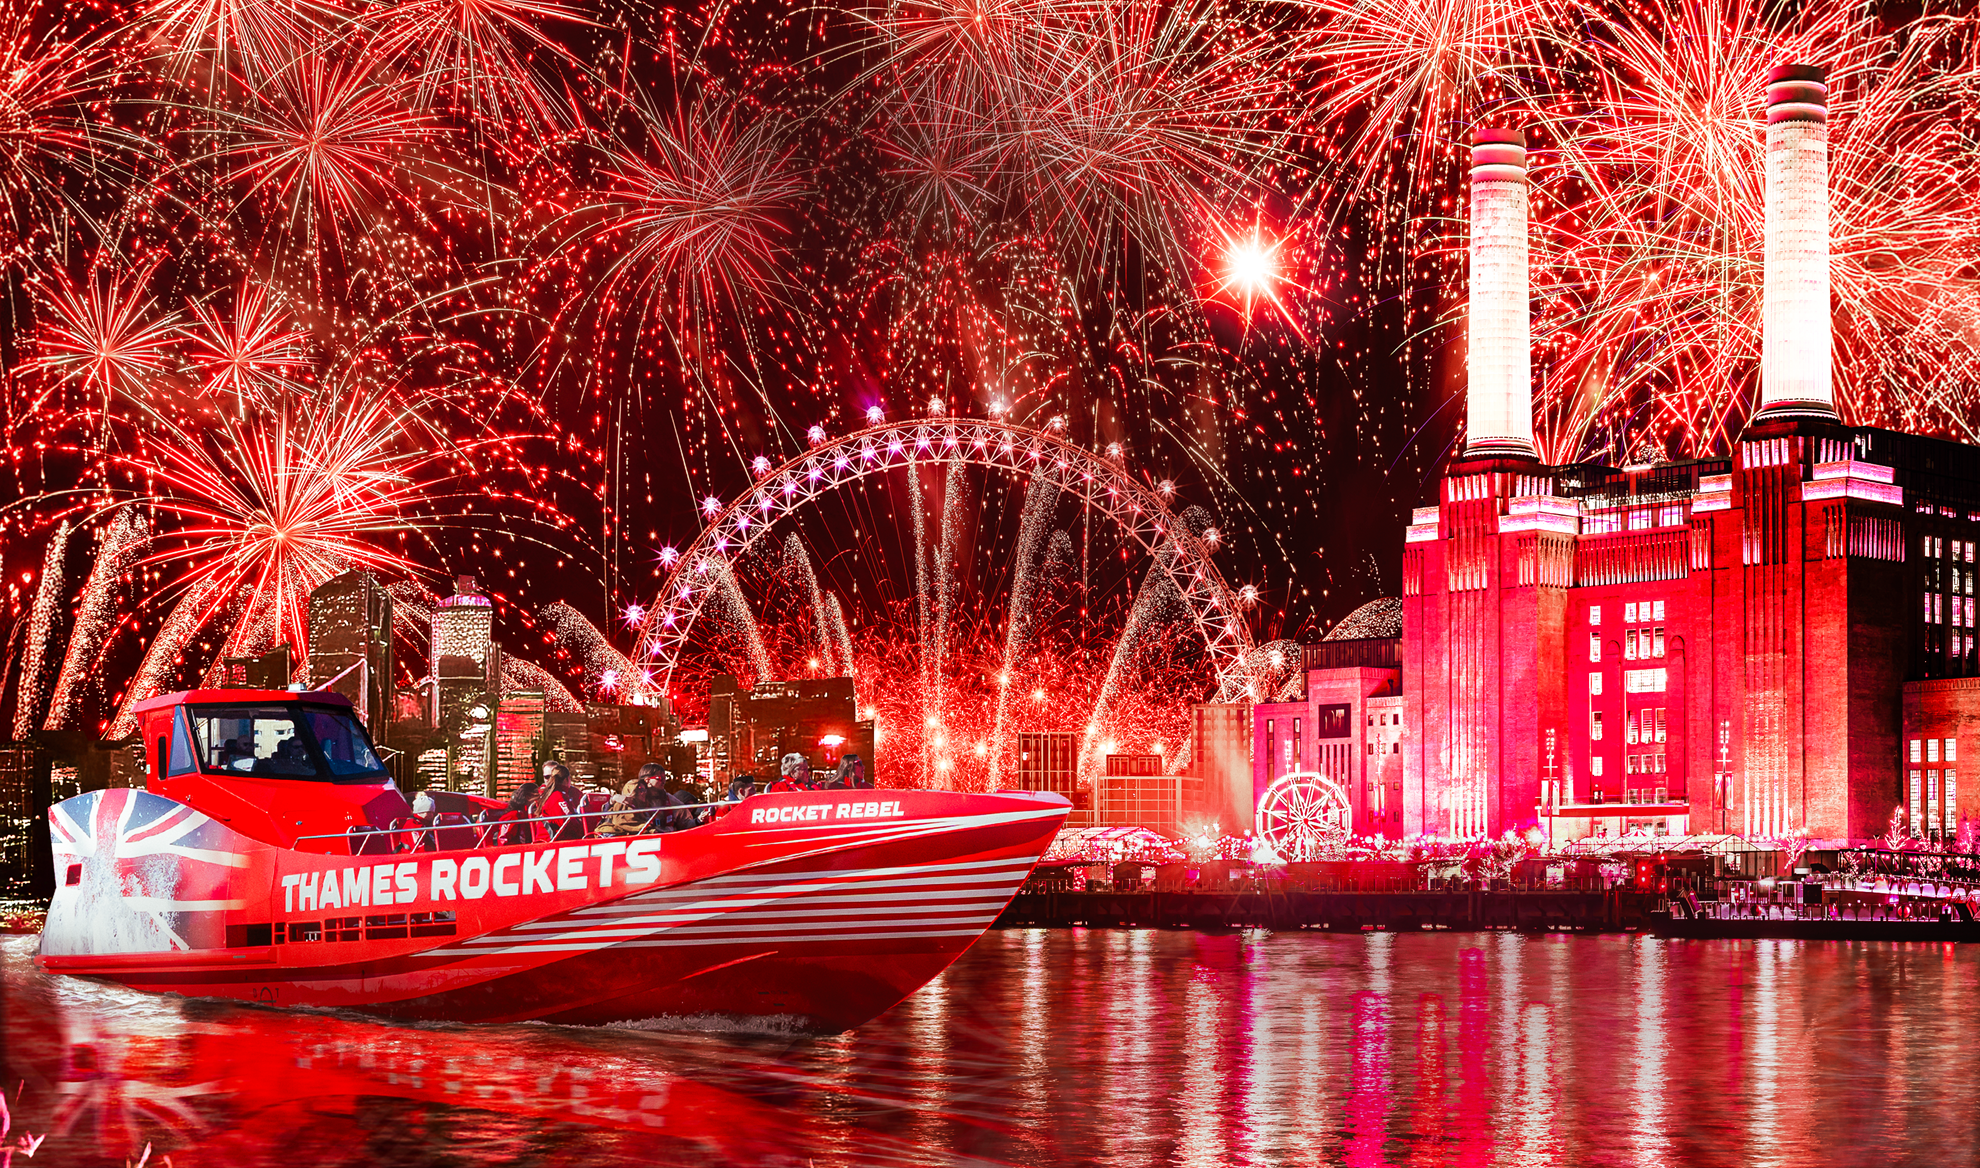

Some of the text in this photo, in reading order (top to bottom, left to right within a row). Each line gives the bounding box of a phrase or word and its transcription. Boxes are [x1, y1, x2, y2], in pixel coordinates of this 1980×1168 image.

[751, 801, 905, 824] ROCKET REBEL
[281, 837, 662, 913] THAMES ROCKETS
